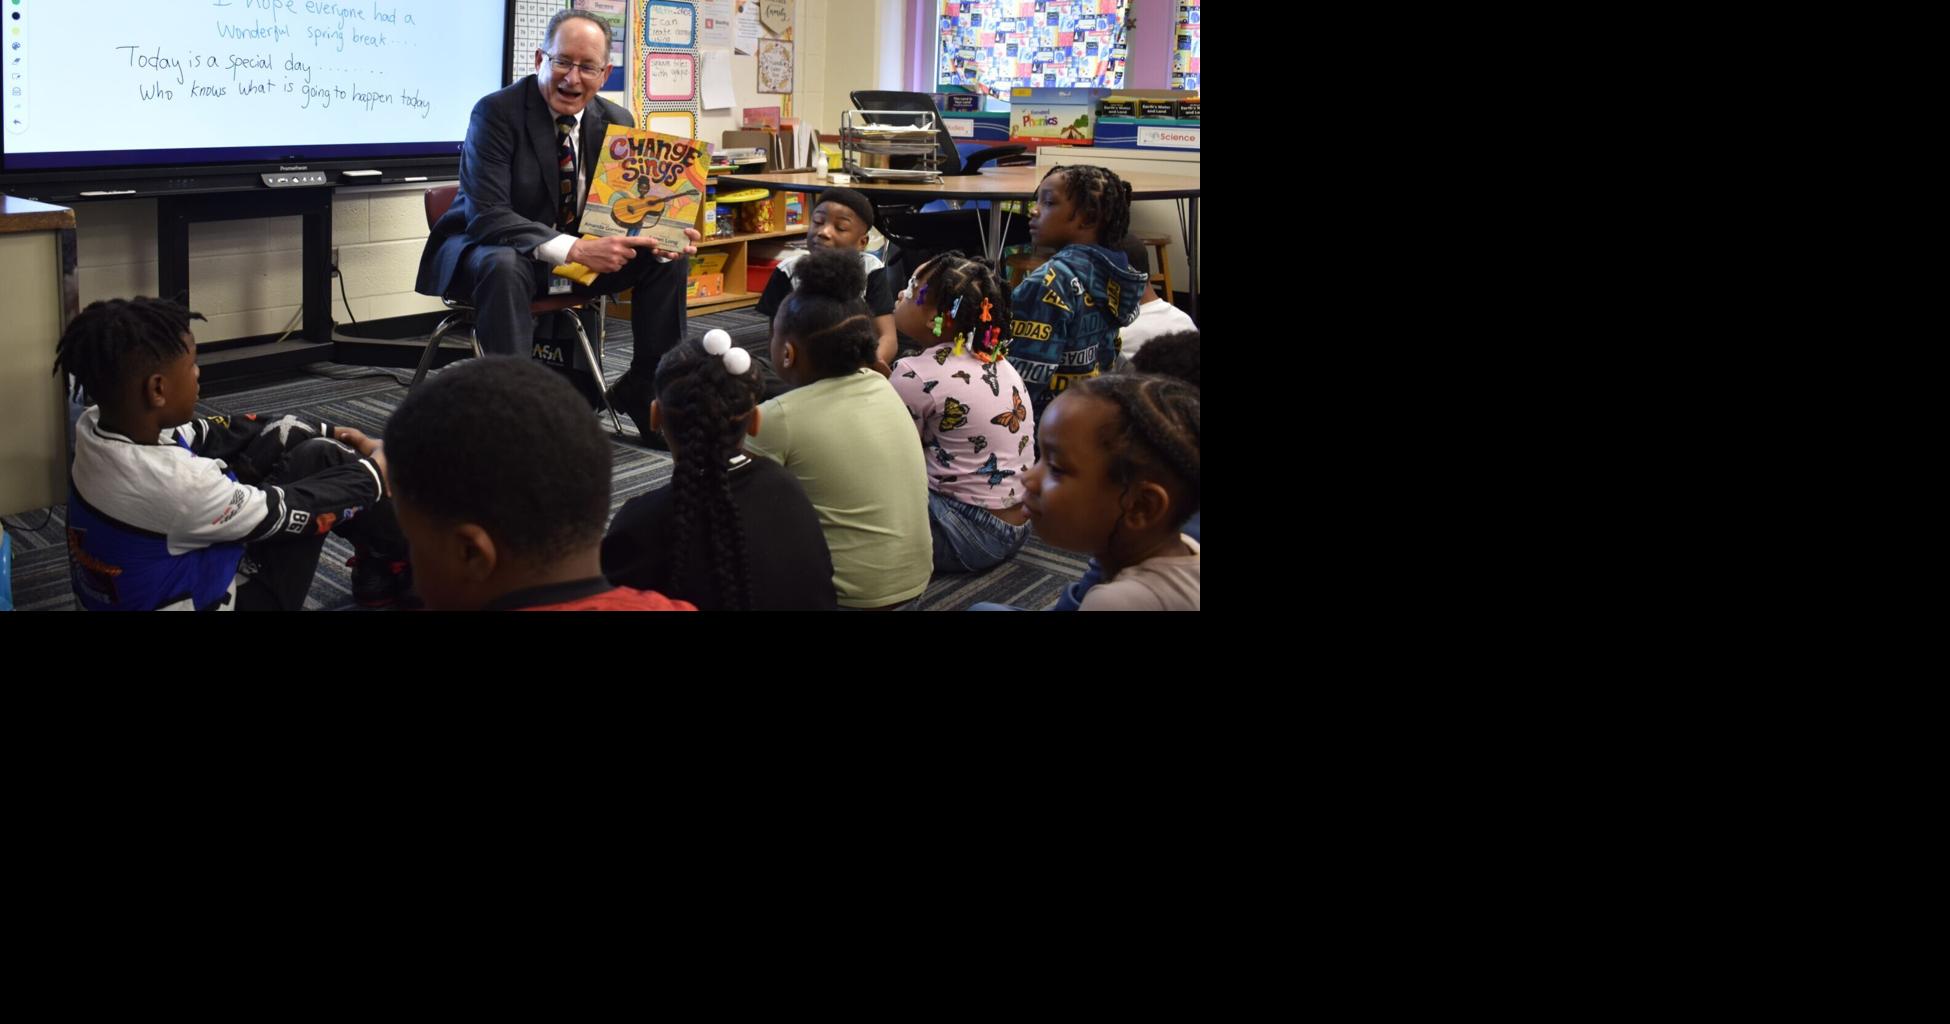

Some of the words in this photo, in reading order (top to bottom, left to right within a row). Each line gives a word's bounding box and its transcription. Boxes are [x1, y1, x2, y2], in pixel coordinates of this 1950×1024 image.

[246, 0, 297, 22] hope
[305, 0, 365, 30] everyone
[373, 3, 396, 25] had
[404, 14, 416, 25] a
[216, 19, 290, 43] Wonderful
[307, 26, 344, 52] spring
[115, 45, 185, 85] Today
[189, 50, 201, 67] is
[206, 54, 219, 68] a
[225, 53, 273, 81] special
[139, 80, 173, 101] Who
[190, 79, 227, 98] knows
[284, 75, 294, 92] is
[300, 82, 330, 109] going
[334, 85, 347, 100] to
[351, 82, 393, 111] happen
[400, 88, 432, 119] today
[1022, 113, 1058, 127] Phonics
[1160, 132, 1196, 142] Science
[621, 157, 684, 186] Sings
